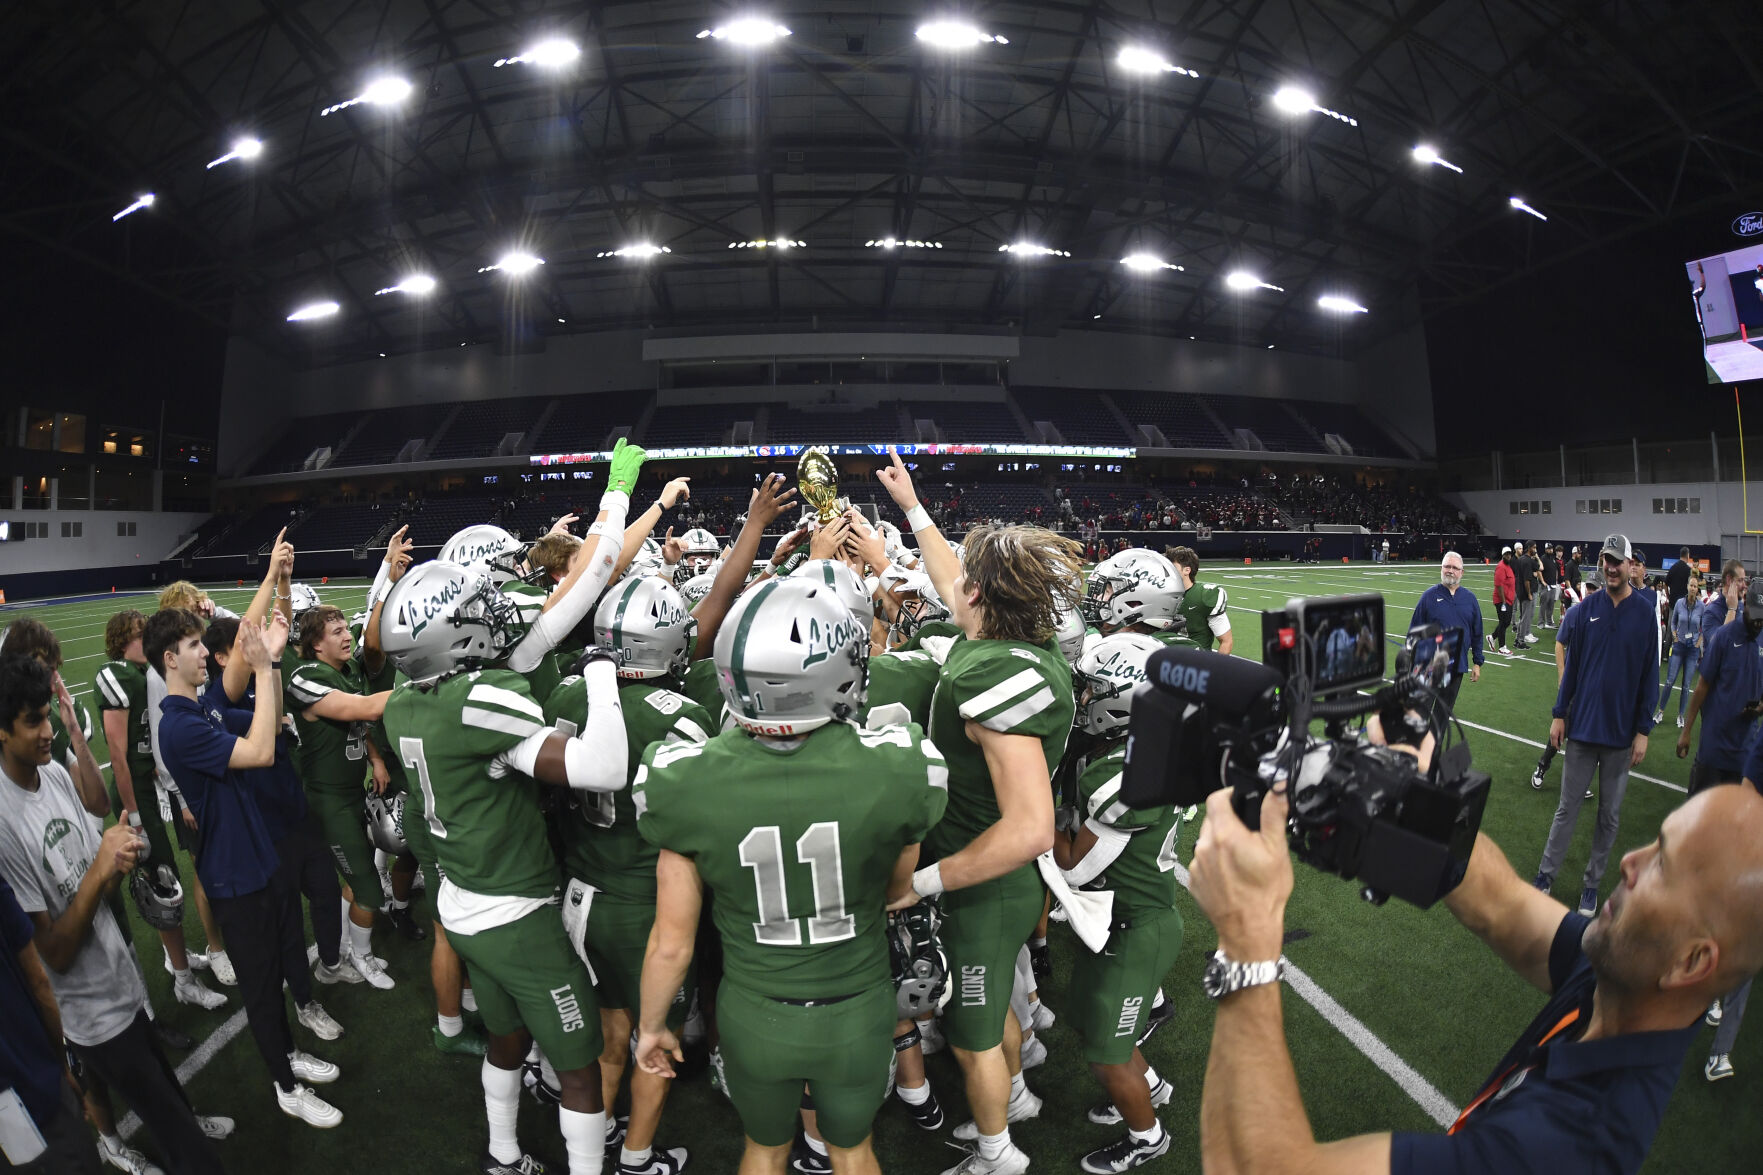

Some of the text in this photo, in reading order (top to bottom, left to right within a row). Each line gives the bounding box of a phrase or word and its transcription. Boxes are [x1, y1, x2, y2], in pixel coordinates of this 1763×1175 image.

[1740, 216, 1763, 233] Ford
[458, 537, 506, 567] Lions
[1607, 536, 1618, 548] R
[407, 576, 465, 640] Lions
[1095, 651, 1147, 683] Lion
[399, 736, 448, 839] 7
[738, 821, 857, 946] 11
[961, 965, 986, 1007] LIONS
[550, 984, 585, 1033] LIONS
[1115, 996, 1144, 1038] LIONS
